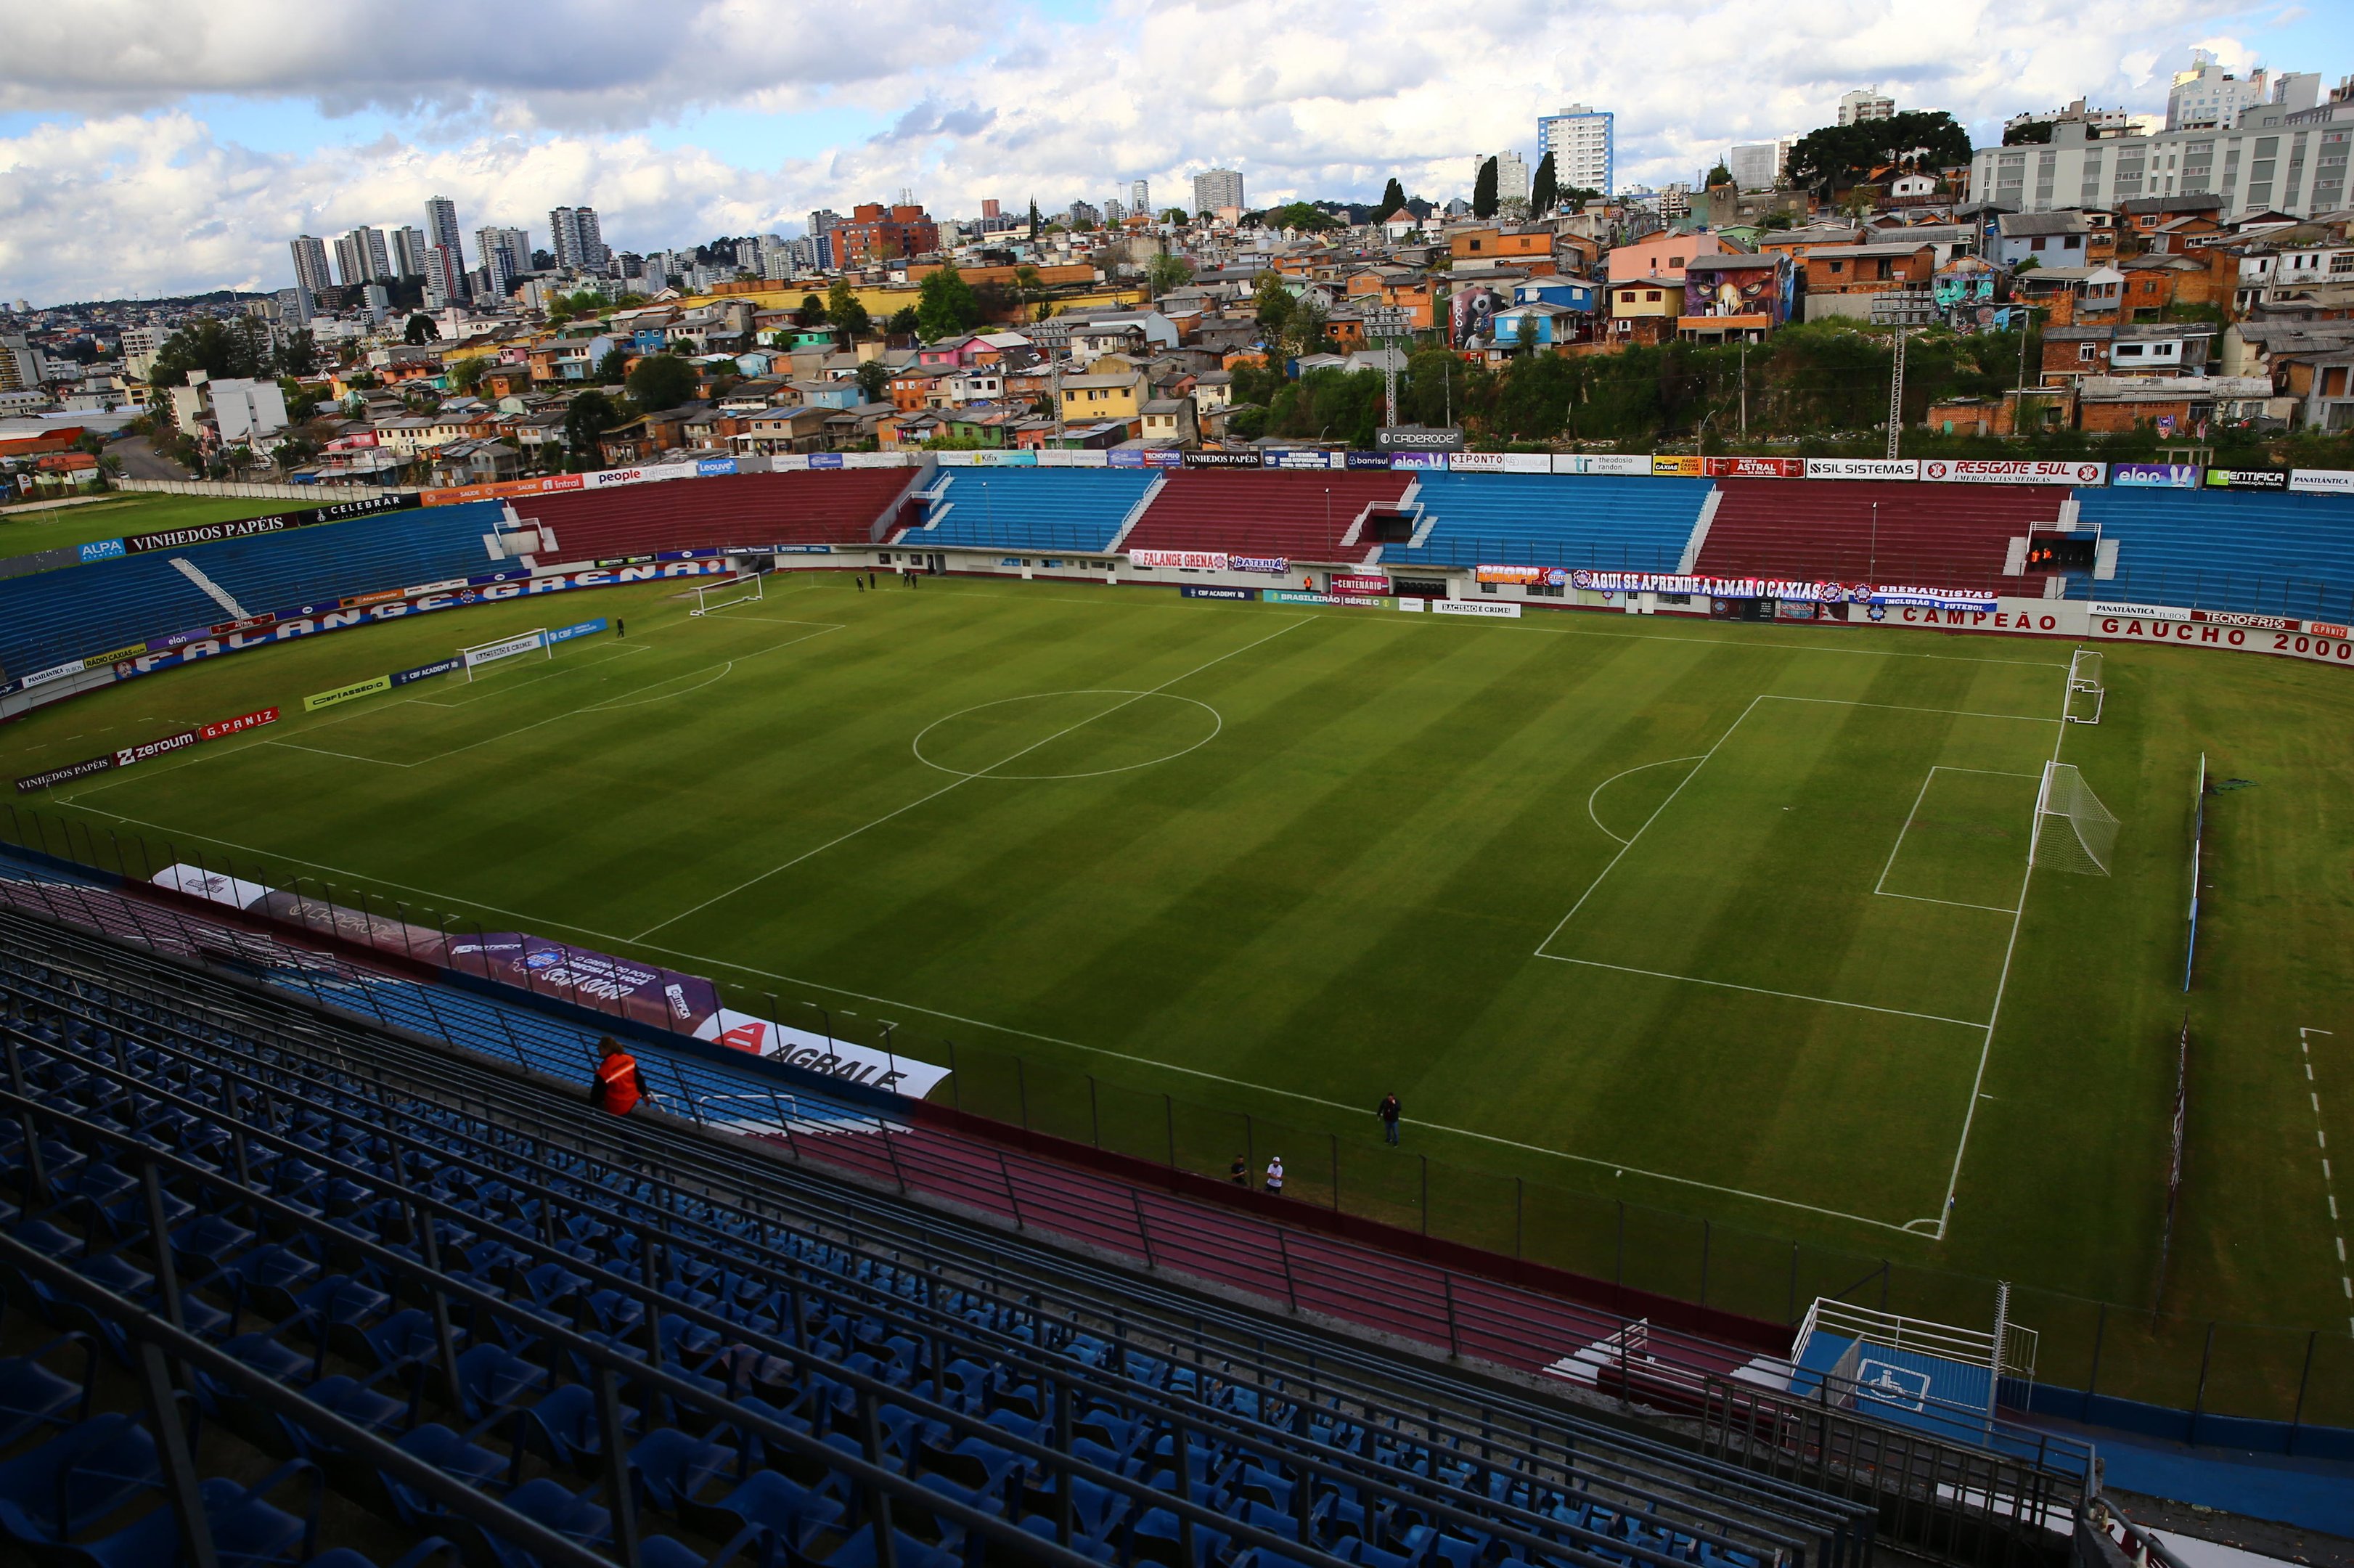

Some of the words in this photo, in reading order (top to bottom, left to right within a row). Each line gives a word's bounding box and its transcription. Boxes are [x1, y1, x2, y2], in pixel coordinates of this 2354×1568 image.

[1393, 433, 1455, 444] CADERODE
[981, 454, 998, 462] Kifix
[1185, 454, 1228, 463] VINHEDOS
[1229, 453, 1259, 463] PAPÉIS
[1357, 457, 1389, 465] banrisul
[1394, 454, 1423, 468] elan
[1451, 454, 1503, 464] KIPONTO
[699, 461, 732, 472] Leouve
[1822, 463, 1842, 473] SIL
[1845, 463, 1914, 474] SISTEMAS
[1955, 461, 2032, 474] RESGATE
[2035, 462, 2070, 475] SUL
[598, 469, 641, 485] people
[2118, 467, 2160, 483] elan
[2218, 470, 2284, 482] IDENTIFICA
[2294, 476, 2348, 485] PANATLÂNTICA
[555, 479, 579, 489] intral
[330, 497, 400, 515] CELEBRAR
[132, 526, 221, 550] VINHEDOS
[224, 516, 285, 538] PAPÉIS
[81, 540, 122, 557] ALPA
[1143, 552, 1182, 567] FALANGE
[1235, 556, 1283, 570] BATERIA
[483, 560, 700, 600] GRENA
[1476, 565, 1540, 585] CHOPP
[1338, 579, 1382, 591] CENTENÁRIO
[1590, 572, 1622, 589] AQUI
[1623, 573, 1638, 590] SE
[1640, 574, 1700, 593] APRENDE
[1701, 578, 1712, 595] A
[1714, 579, 1754, 597] AMAR
[1755, 580, 1765, 597] O
[1766, 581, 1821, 600] CAXIAS
[1879, 585, 1993, 599] GRENAUTISTAS
[1281, 593, 1341, 604] BRASILEIRÃO
[1344, 595, 1373, 605] SÉRIE
[1885, 598, 1929, 607] INCLUSÃO
[1944, 603, 1985, 612] FUTEBOL
[1442, 603, 1477, 613] RACISMO
[2096, 605, 2155, 616] PANATLÂNTICA
[2158, 611, 2186, 620] TUBOS
[1903, 608, 2056, 630] CAMPEÃO
[135, 592, 453, 672] FALANGE
[557, 629, 573, 639] CBF
[2101, 618, 2245, 645] GAÚCHO
[2273, 634, 2352, 660] 2000
[168, 635, 187, 645] elan
[86, 656, 108, 667] RÁDIO
[109, 649, 133, 661] CAXIAS
[28, 666, 64, 684] PANATLÂNTICA
[409, 670, 421, 679] CBF
[422, 663, 450, 677] ACADEMY
[136, 732, 194, 759] zeroum
[18, 769, 73, 791] VINHEDOS
[74, 759, 108, 776] PAPÉIS
[568, 960, 605, 975] PRECISA
[628, 969, 656, 981] POVO
